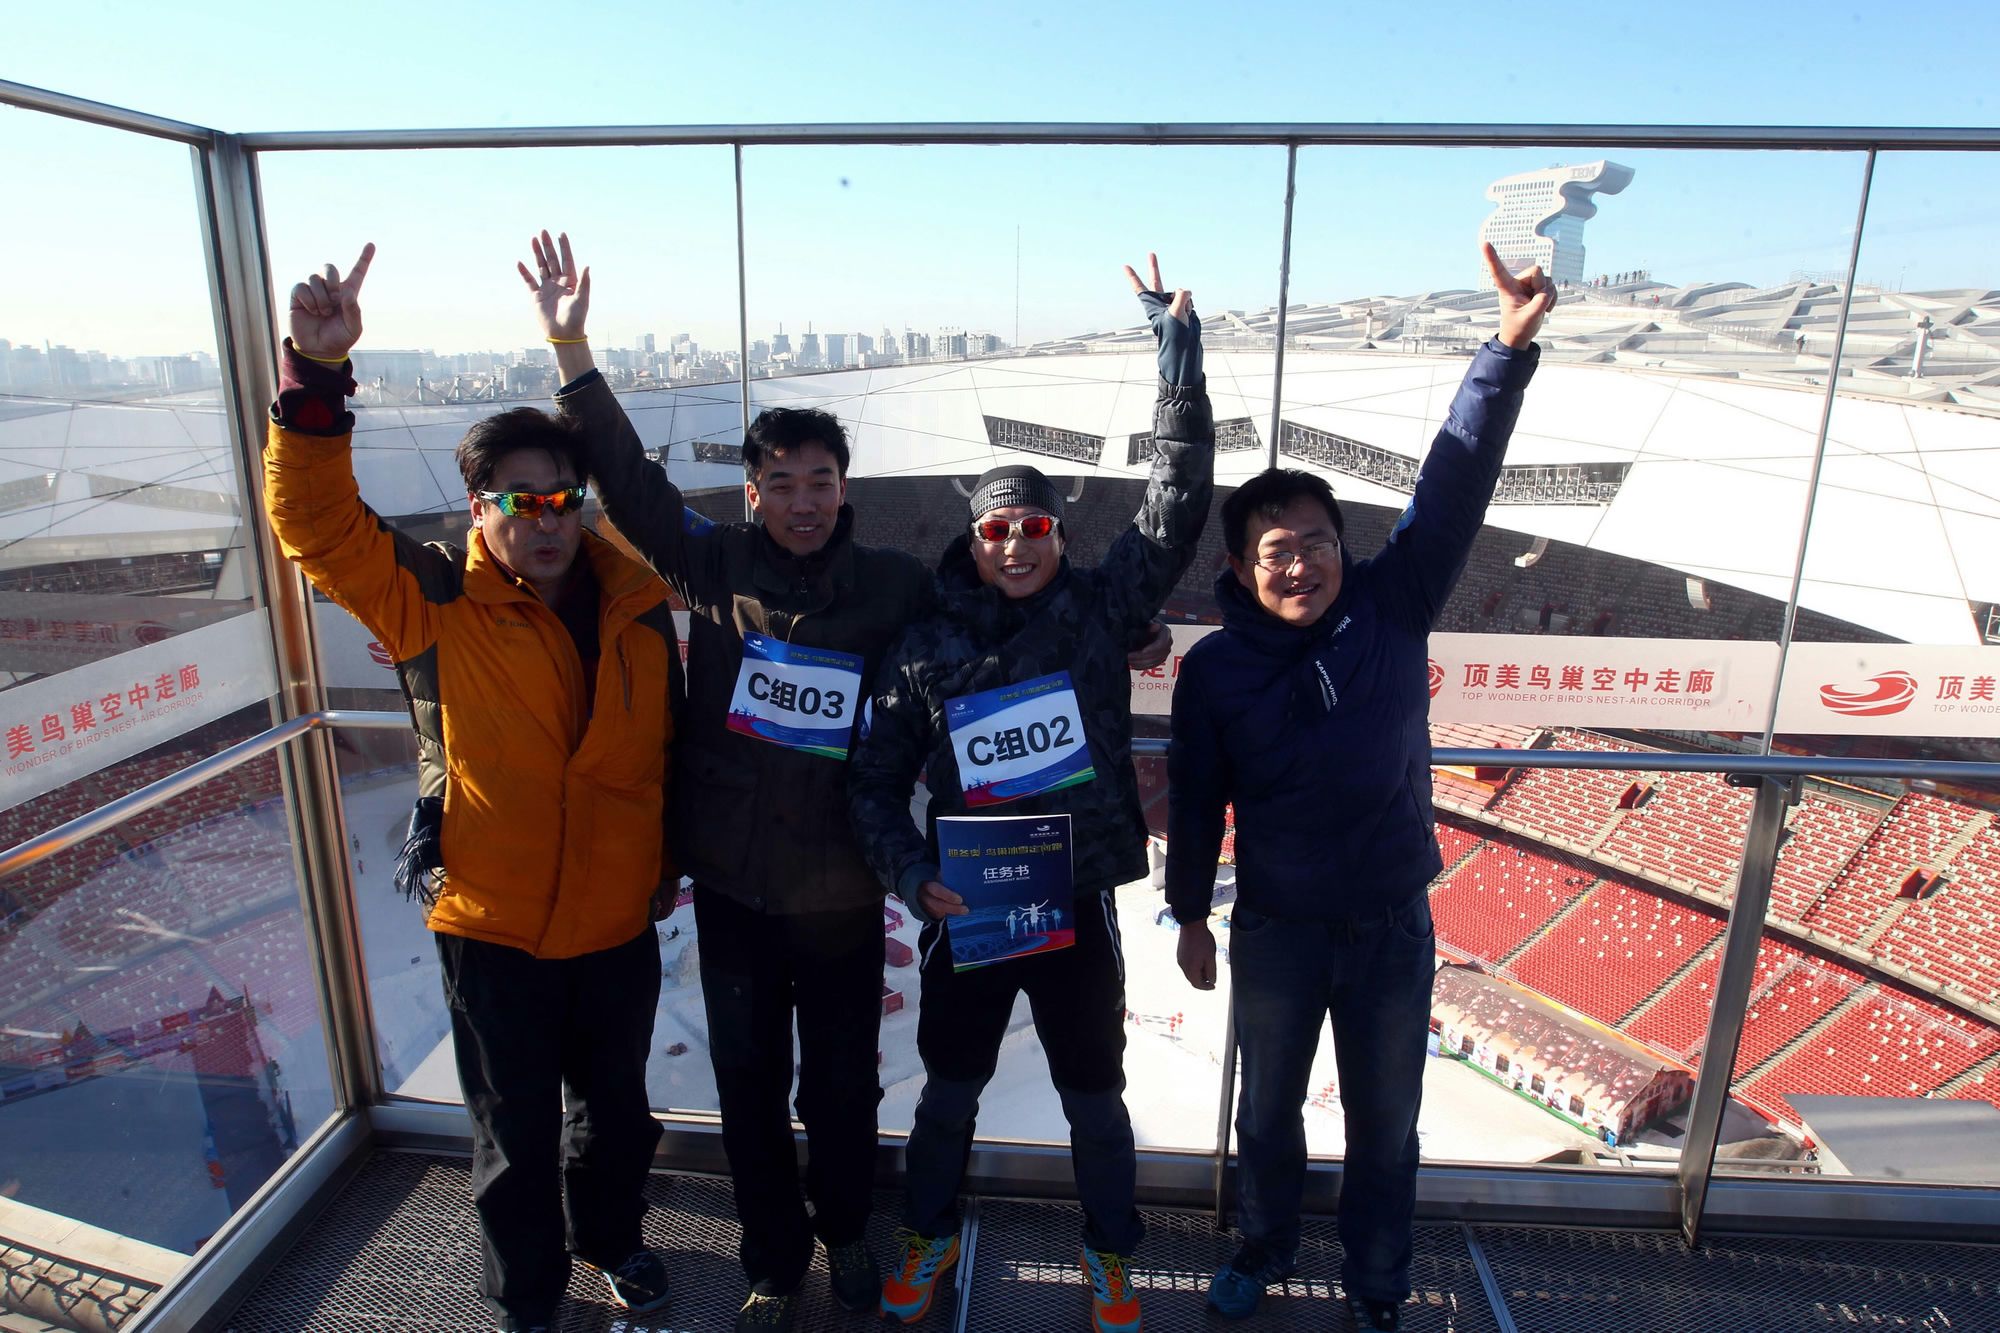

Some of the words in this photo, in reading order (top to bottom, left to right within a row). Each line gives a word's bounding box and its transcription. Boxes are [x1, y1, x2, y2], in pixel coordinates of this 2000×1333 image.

[1315, 660, 1331, 685] KAPPA
[1463, 663, 1715, 694] 顶美鸟巢空中走廊
[747, 672, 845, 719] C组03
[1461, 691, 1483, 700] TOP
[1488, 692, 1537, 702] WONDER
[1539, 693, 1555, 702] OF
[1557, 694, 1594, 704] BIRD'S
[1650, 697, 1711, 707] CORRIDOR
[1936, 676, 1997, 701] 顶美
[1934, 704, 1955, 713] TOP
[5, 749, 57, 777] WONDER
[60, 742, 73, 755] OF
[157, 692, 204, 716] CORRIDOR
[967, 715, 1075, 767] C组02
[982, 864, 1030, 880] 任务书
